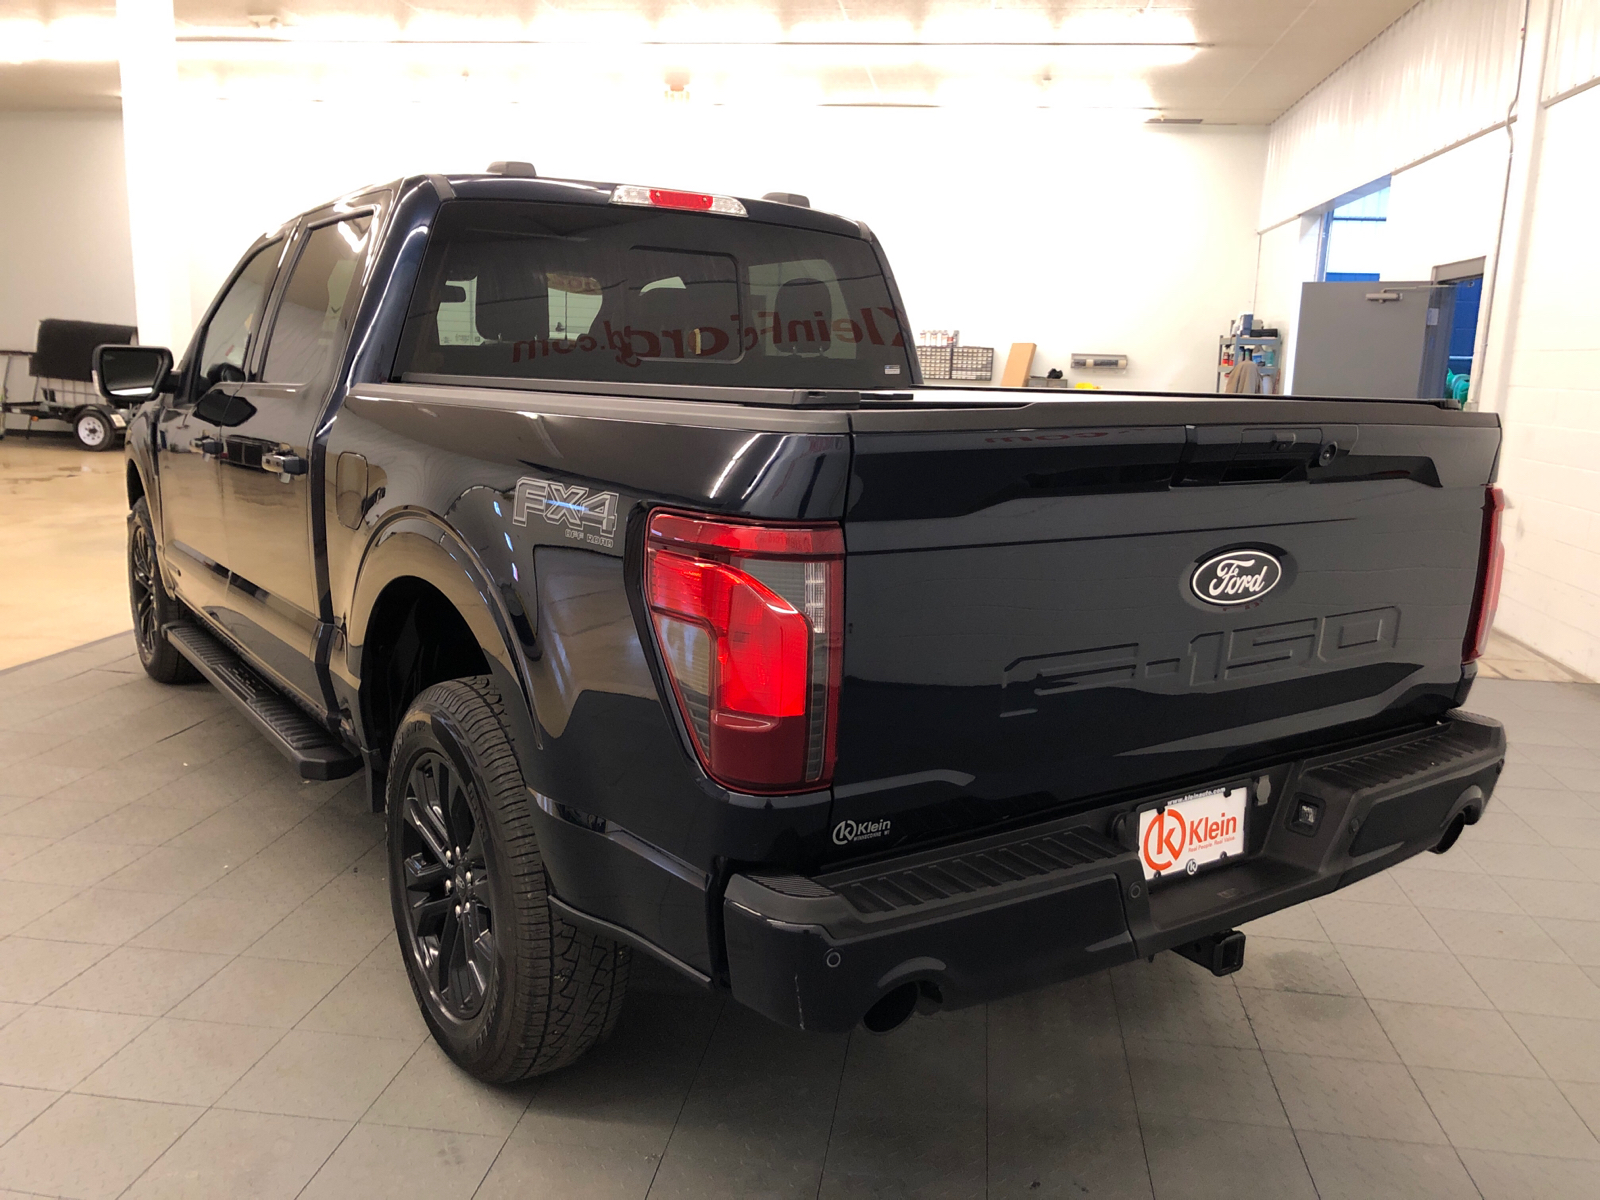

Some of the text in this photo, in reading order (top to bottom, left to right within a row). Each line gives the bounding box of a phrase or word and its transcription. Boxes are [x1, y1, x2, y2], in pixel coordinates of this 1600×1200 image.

[512, 476, 619, 537] FX4
[1208, 559, 1268, 596] Ford
[1000, 605, 1401, 718] F-150
[1167, 787, 1226, 806] www.kleinauto.com
[857, 819, 891, 835] Klein
[1188, 812, 1237, 846] Klein
